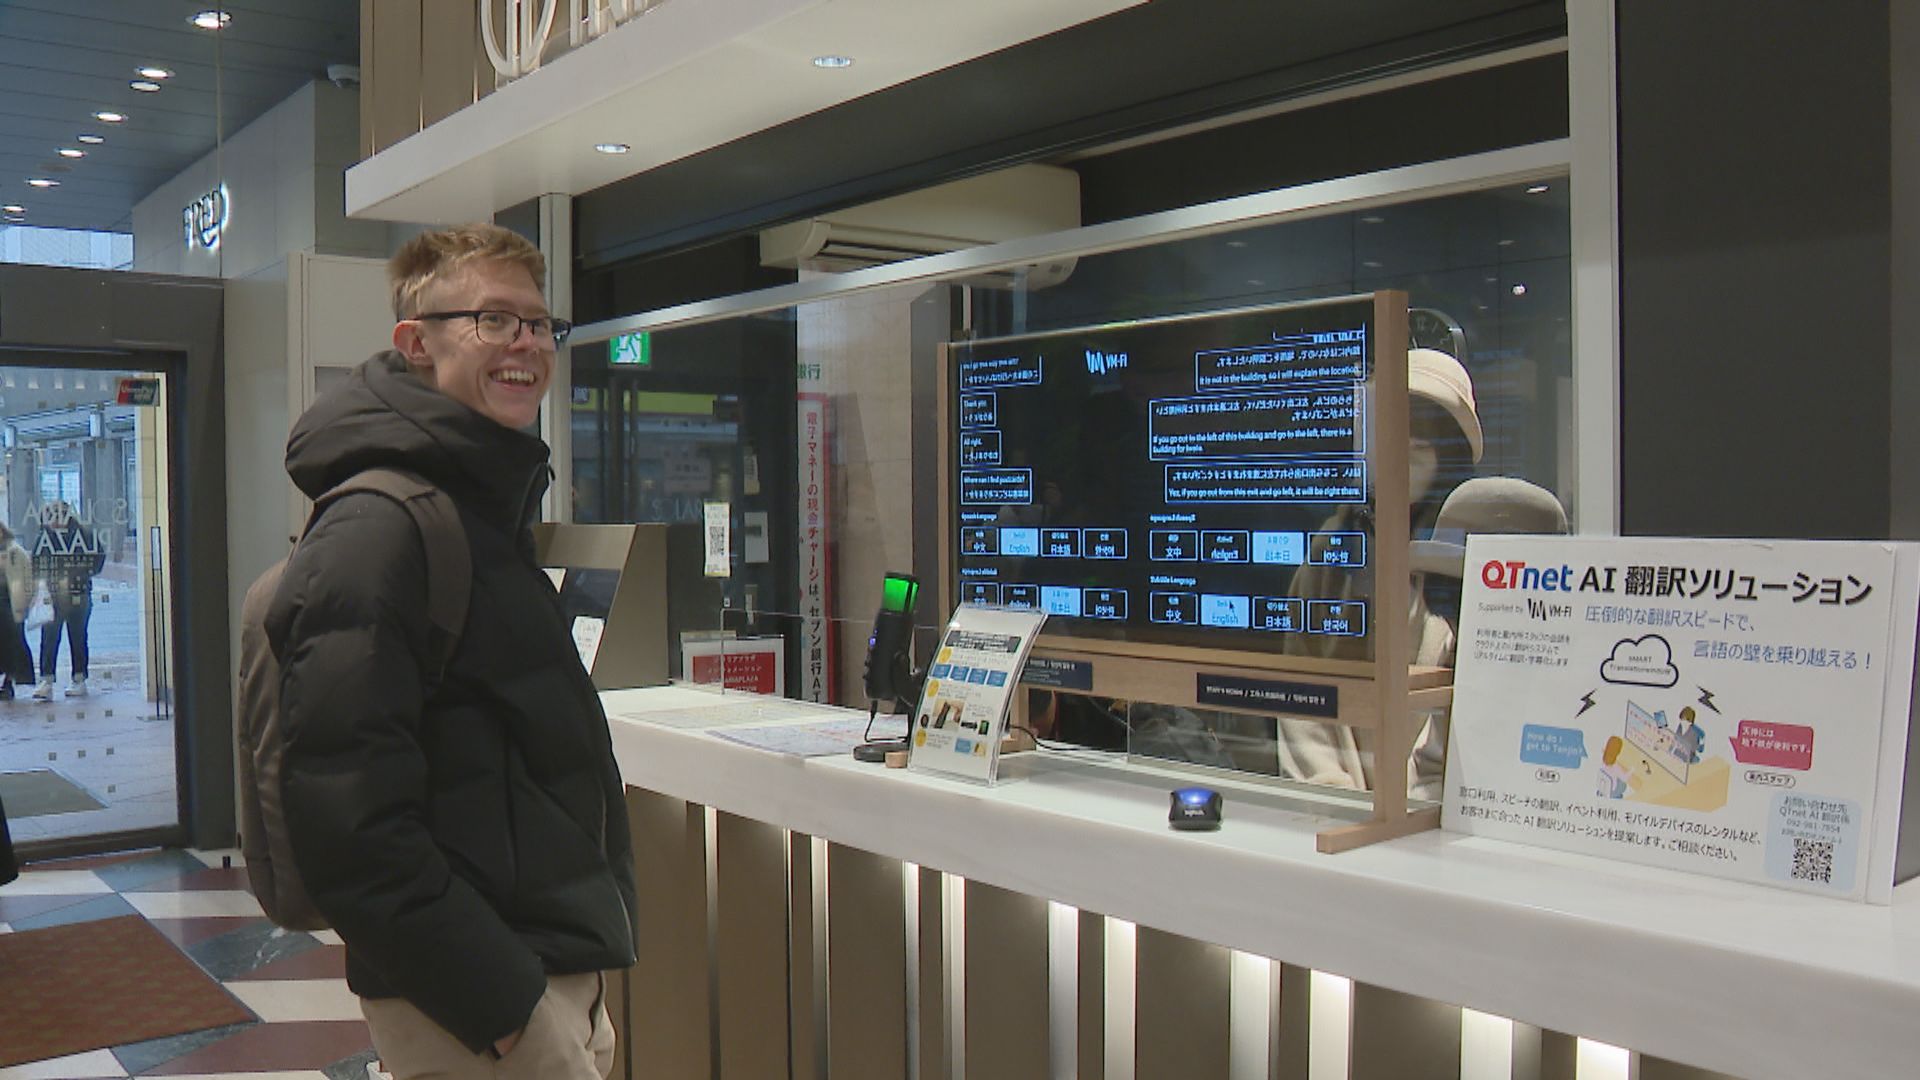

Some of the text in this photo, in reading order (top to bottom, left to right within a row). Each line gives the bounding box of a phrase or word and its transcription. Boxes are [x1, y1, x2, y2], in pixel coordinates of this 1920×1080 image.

[1481, 560, 1873, 605] QTnet AI 翻訳ソリューション
[1549, 604, 1573, 618] VM-FI
[1212, 613, 1239, 625] English
[1265, 616, 1291, 629] 日本語
[1323, 619, 1348, 632] 한국어
[1585, 606, 1755, 632] 圧倒的な翻訳スピードで、
[1742, 727, 1774, 738] 天神には
